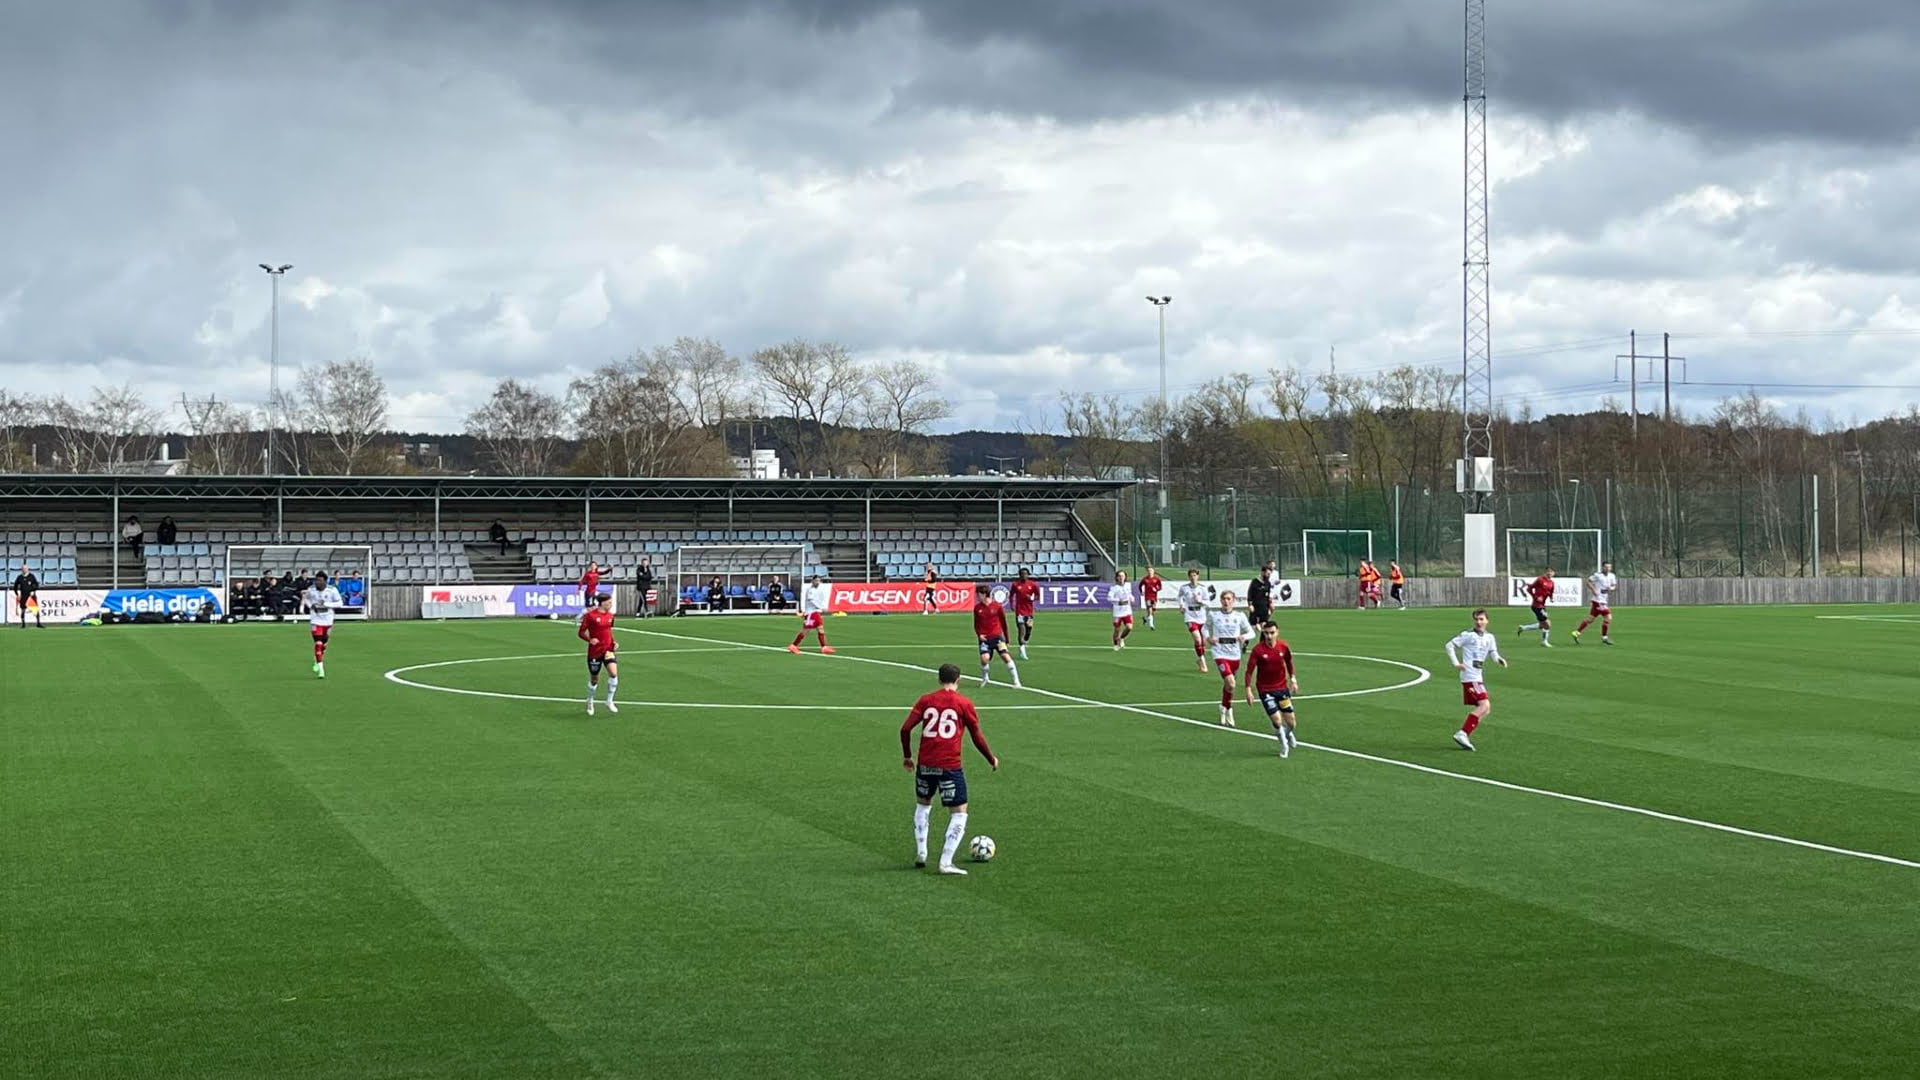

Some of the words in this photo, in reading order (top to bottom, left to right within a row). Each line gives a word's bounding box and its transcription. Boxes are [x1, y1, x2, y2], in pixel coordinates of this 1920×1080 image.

[41, 599, 90, 608] SVENSKA
[525, 590, 562, 609] Heja
[835, 590, 912, 605] PULSEN
[915, 589, 970, 604] GROUP
[41, 608, 67, 617] SPEL
[923, 707, 958, 739] 26
